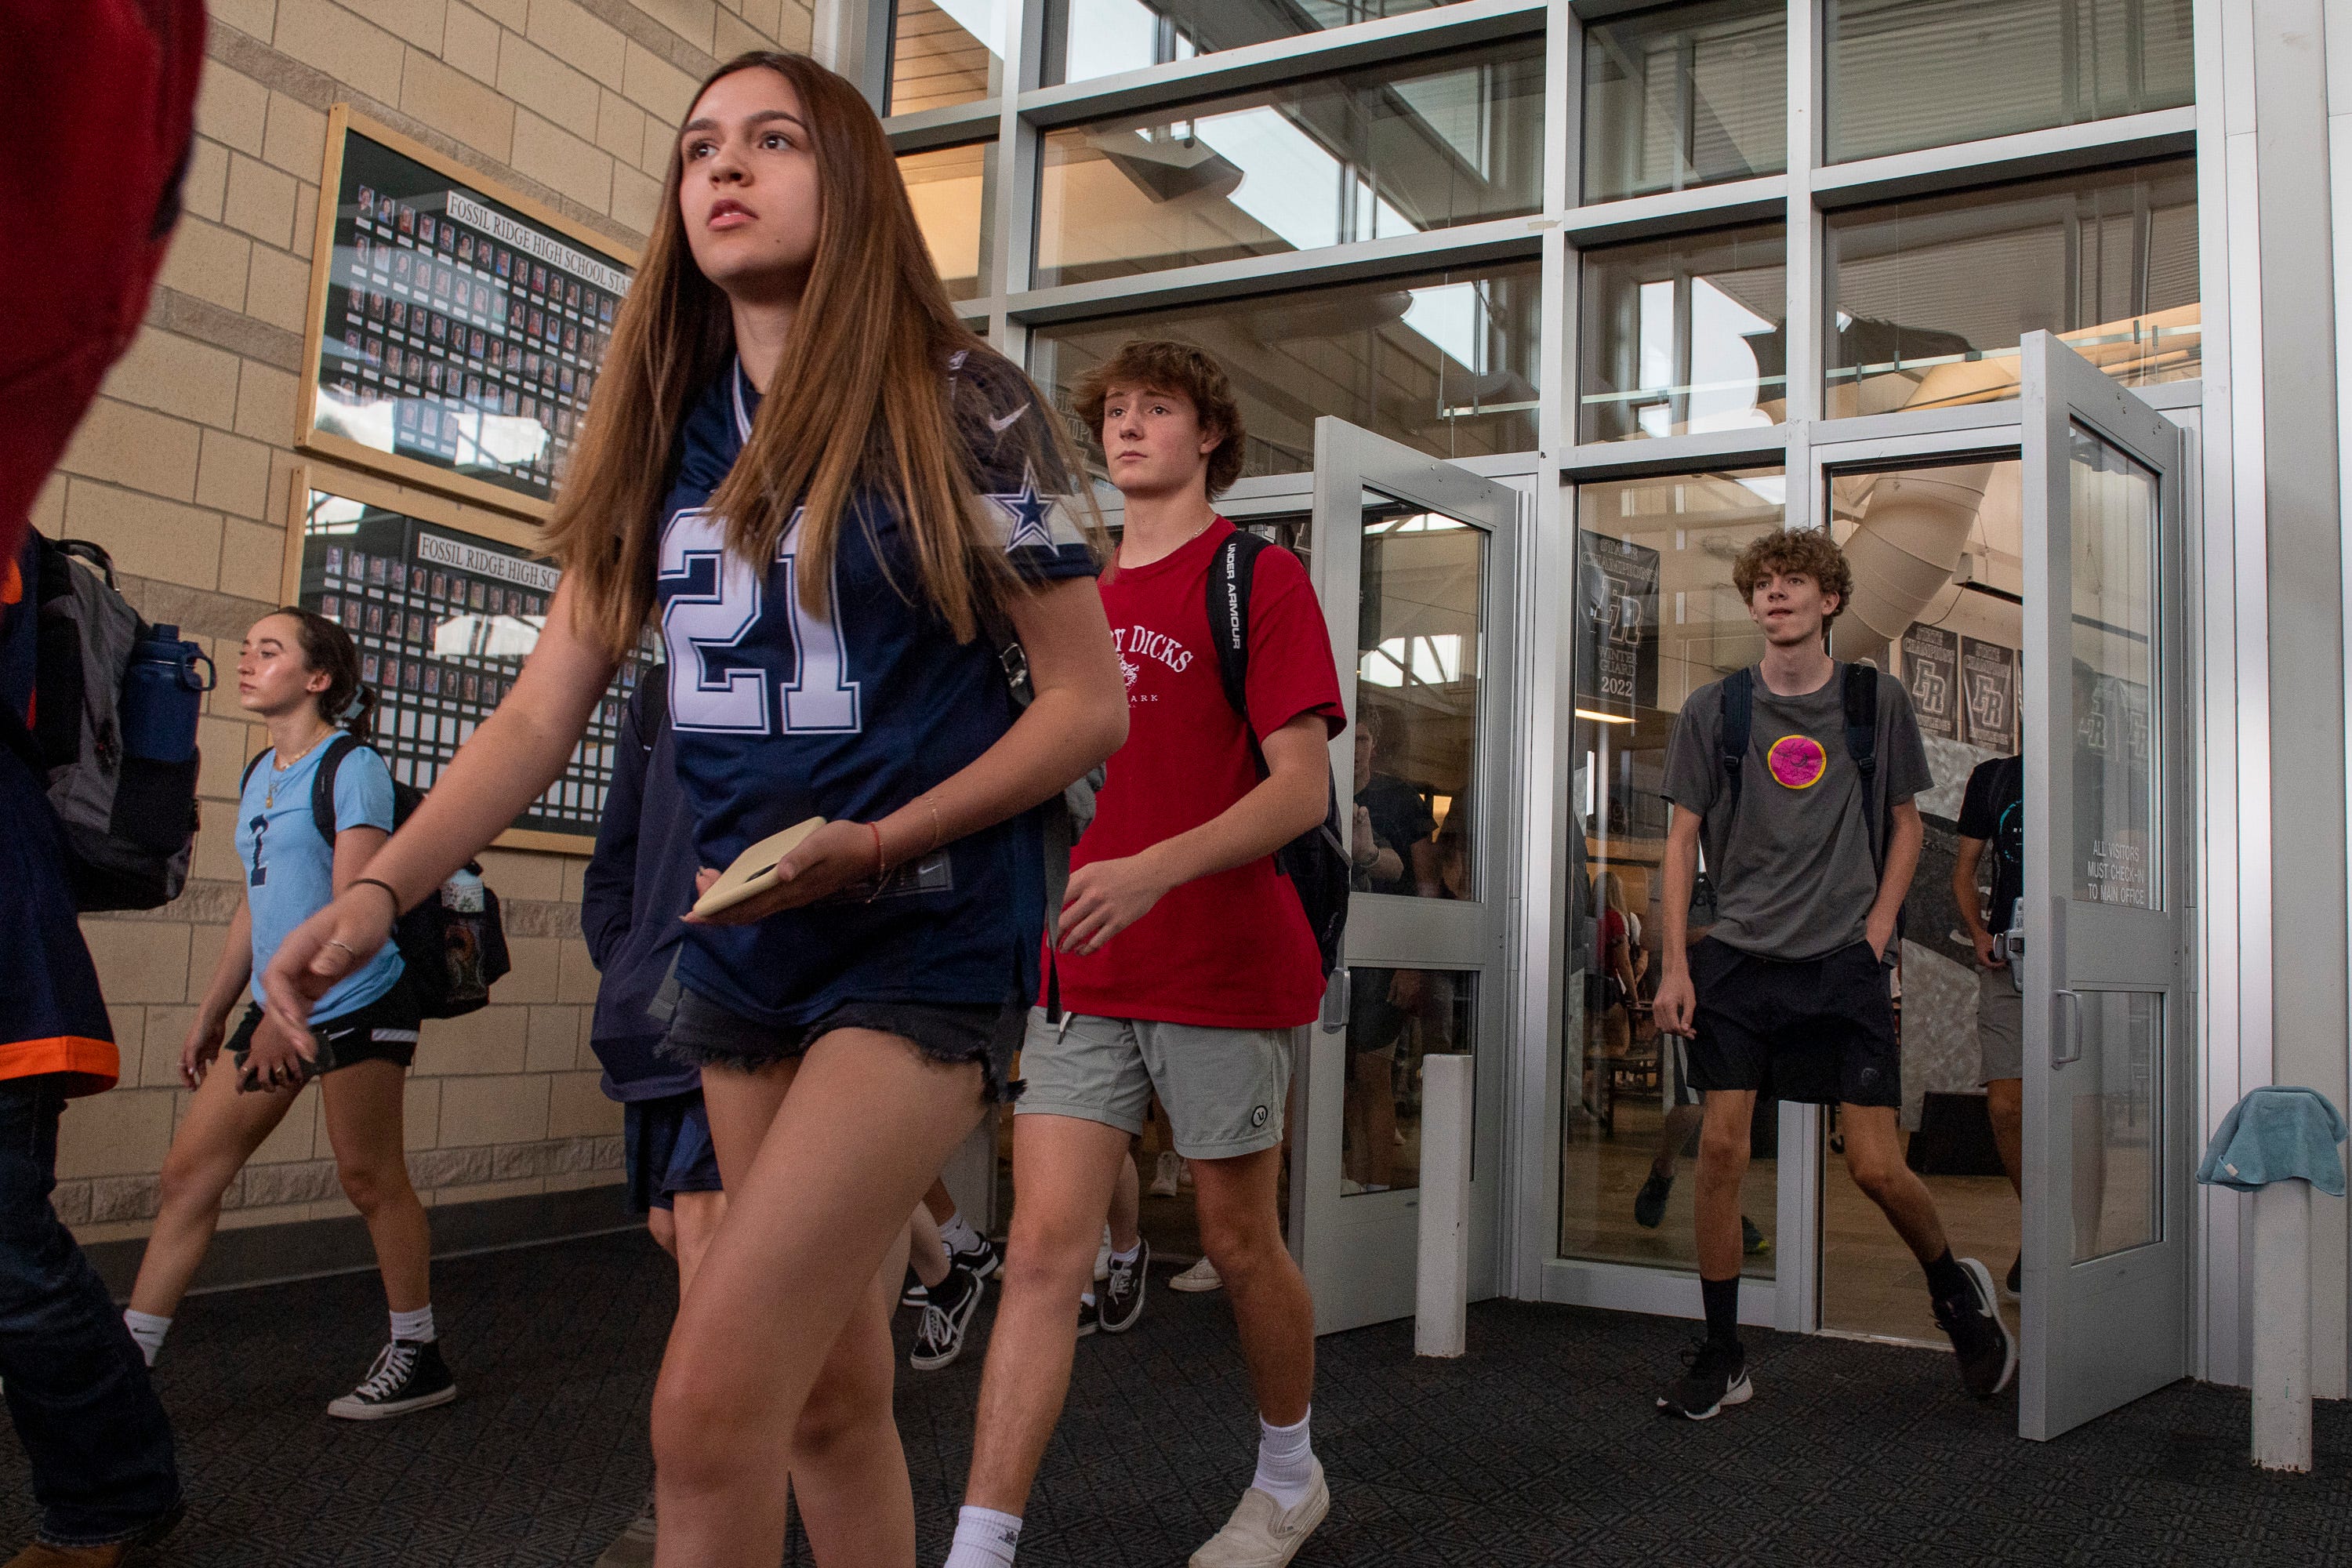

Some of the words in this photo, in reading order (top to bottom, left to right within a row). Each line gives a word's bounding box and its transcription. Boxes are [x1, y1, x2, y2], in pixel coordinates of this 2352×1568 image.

[450, 195, 490, 230] FOSSIL
[493, 216, 531, 249] RIDGE
[532, 234, 562, 263] HIGH
[564, 250, 607, 288] SCHOOL
[422, 536, 463, 566] FOSSIL
[466, 549, 506, 577] RIDGE
[508, 561, 539, 586] HIGH
[1226, 543, 1236, 579] UNDER
[658, 506, 862, 735] 21
[1227, 583, 1241, 649] ARMOUR
[1128, 625, 1193, 673] DICKS
[1598, 645, 1637, 665] WINTER
[1601, 676, 1633, 699] 2022
[2092, 840, 2107, 857] ALL
[2108, 842, 2140, 862] VISITORS
[2087, 861, 2108, 879] MUST
[2110, 864, 2144, 884] CHECK-IN
[2088, 883, 2098, 900] TO
[2101, 884, 2118, 902] MAIN
[2120, 887, 2145, 905] OFFICE
